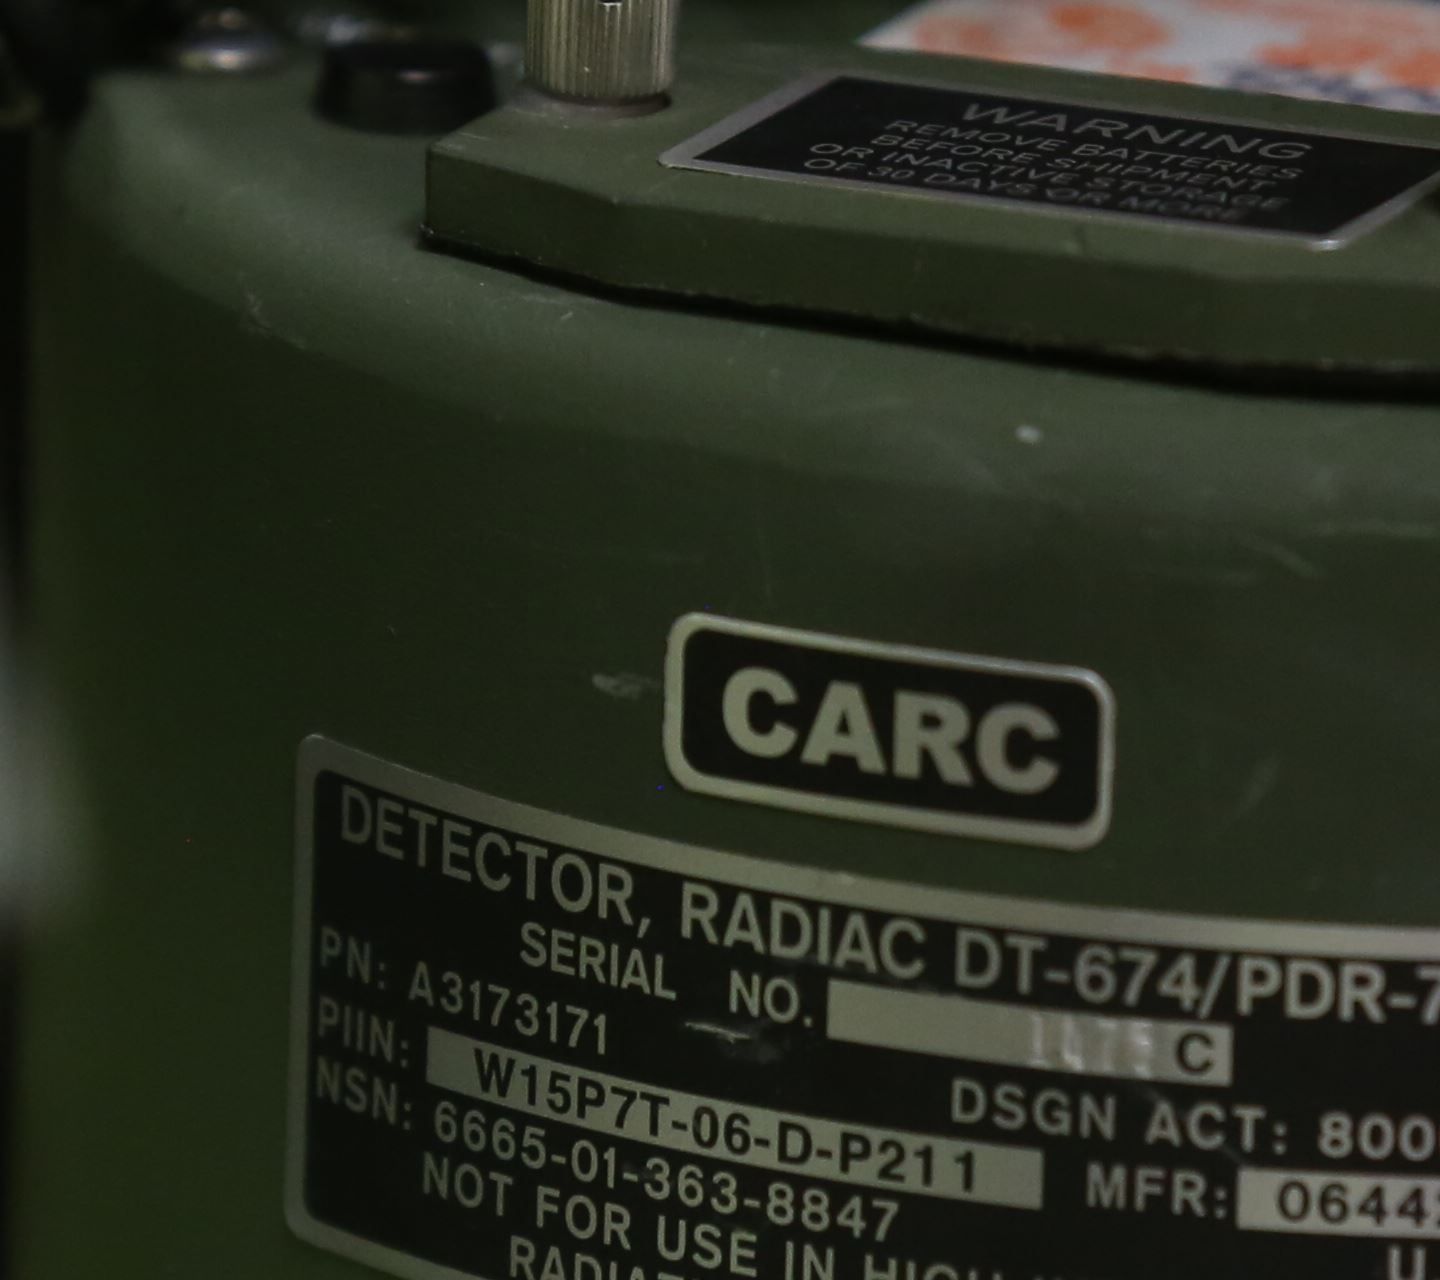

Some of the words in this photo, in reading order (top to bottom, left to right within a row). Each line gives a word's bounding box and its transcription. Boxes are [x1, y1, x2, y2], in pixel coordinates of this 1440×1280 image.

[871, 135, 1041, 163] BEFORE
[1046, 158, 1277, 190] SHIPMENT
[885, 120, 1067, 151] REMOVE
[1072, 143, 1304, 179] BATTERIES
[963, 103, 1312, 159] WARNING
[804, 158, 864, 171] OF
[868, 167, 915, 179] 30
[924, 173, 1037, 194] DAYS
[1046, 188, 1111, 205] OR
[1118, 197, 1250, 219] MORE
[810, 143, 874, 158] OR
[882, 152, 1079, 184] INACTIVE
[1085, 177, 1290, 208] STORAGE
[722, 666, 1059, 794] CARC
[341, 784, 651, 938] DETECTOR,
[680, 881, 926, 979] RADIAC
[319, 926, 385, 990] PN:
[408, 961, 606, 1055] A3173171
[519, 921, 677, 1001] SERIAL
[729, 970, 812, 1028] NO.
[1175, 1031, 1215, 1074] C
[317, 996, 409, 1067] PIIN:
[316, 1060, 412, 1130] NSN:
[433, 1100, 899, 1242] 6665-01-363-8847
[951, 1076, 1117, 1141] DSGN
[1145, 1099, 1288, 1155] ACT:
[423, 1151, 513, 1216] NOT
[536, 1185, 631, 1250] FOR
[657, 1215, 758, 1277] USE
[1085, 1162, 1228, 1218] MFR:
